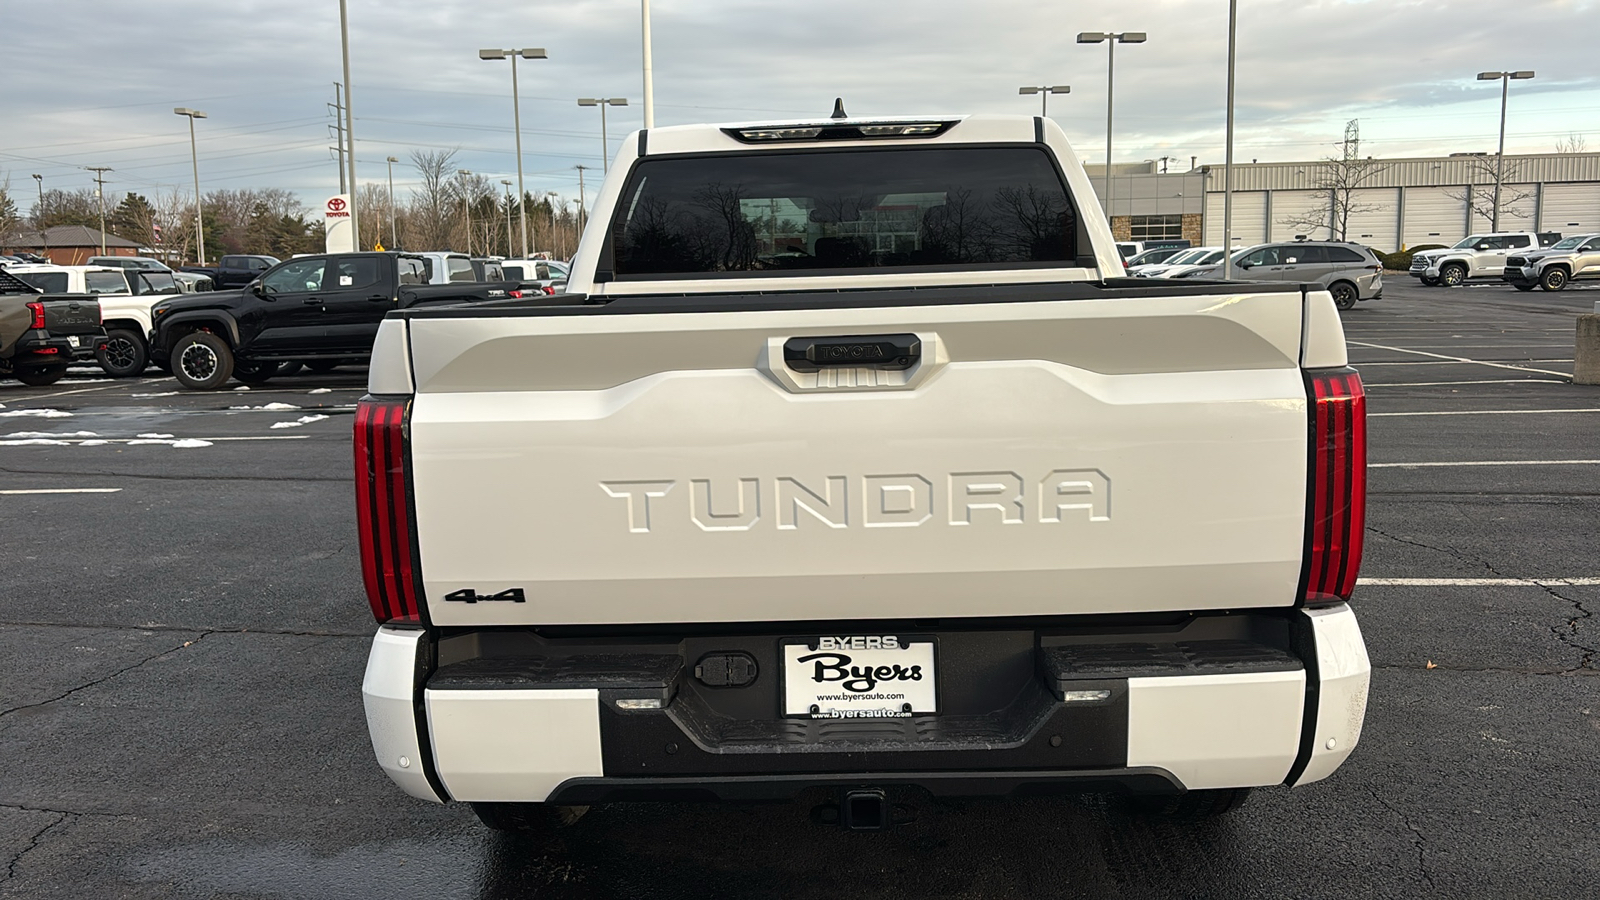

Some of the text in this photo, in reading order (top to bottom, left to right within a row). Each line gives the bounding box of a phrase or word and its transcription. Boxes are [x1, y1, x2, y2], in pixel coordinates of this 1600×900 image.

[821, 345, 884, 359] TOYOTA
[599, 468, 1112, 533] TUNDRA
[819, 635, 899, 650] BYERS
[796, 652, 923, 693] Byers
[816, 692, 905, 702] www.byersauto.com
[811, 707, 912, 720] www.byersauto.com
